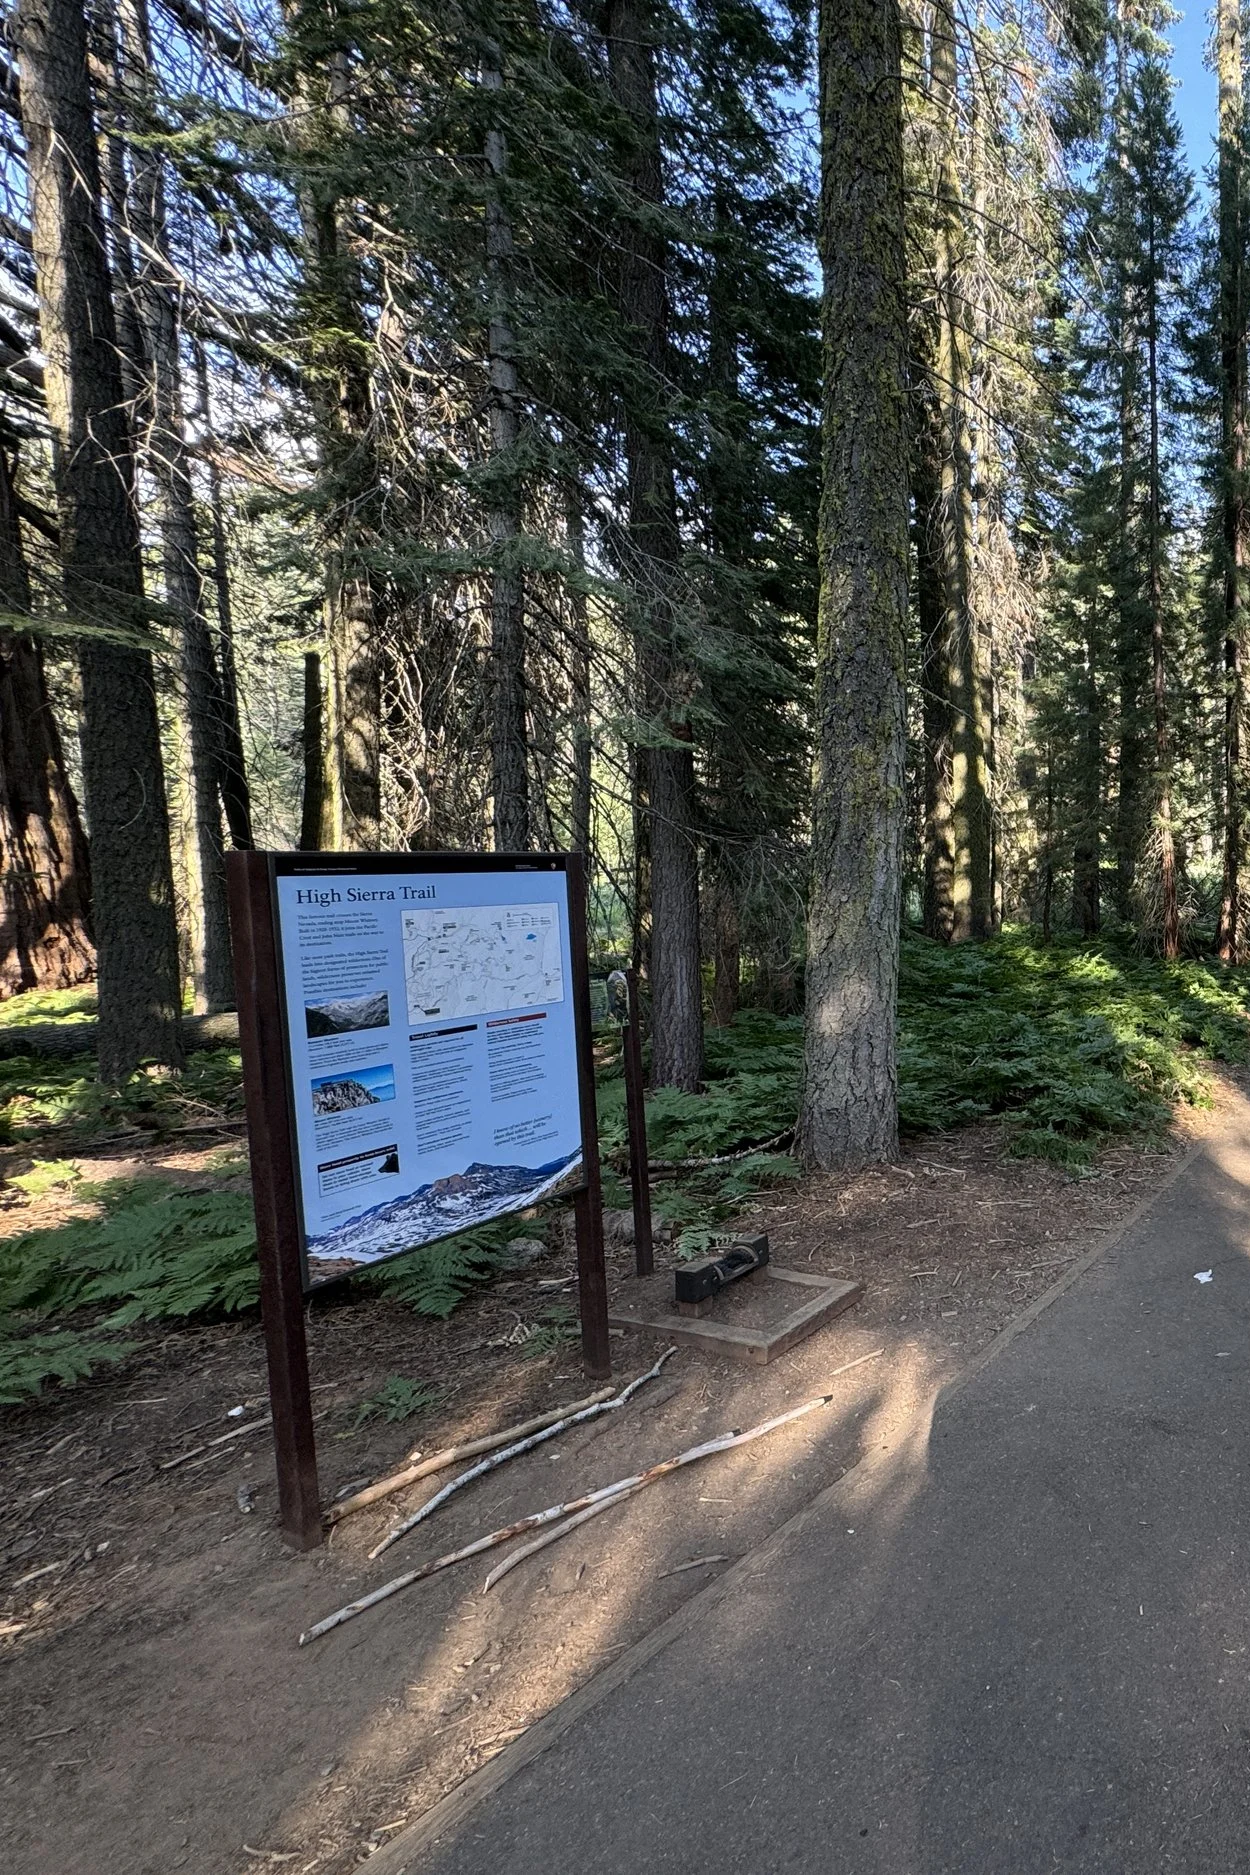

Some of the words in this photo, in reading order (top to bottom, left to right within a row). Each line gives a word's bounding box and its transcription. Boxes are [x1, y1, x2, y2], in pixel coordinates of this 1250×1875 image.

[296, 889, 341, 907] High
[347, 888, 395, 902] Sierra
[399, 885, 436, 899] Trail
